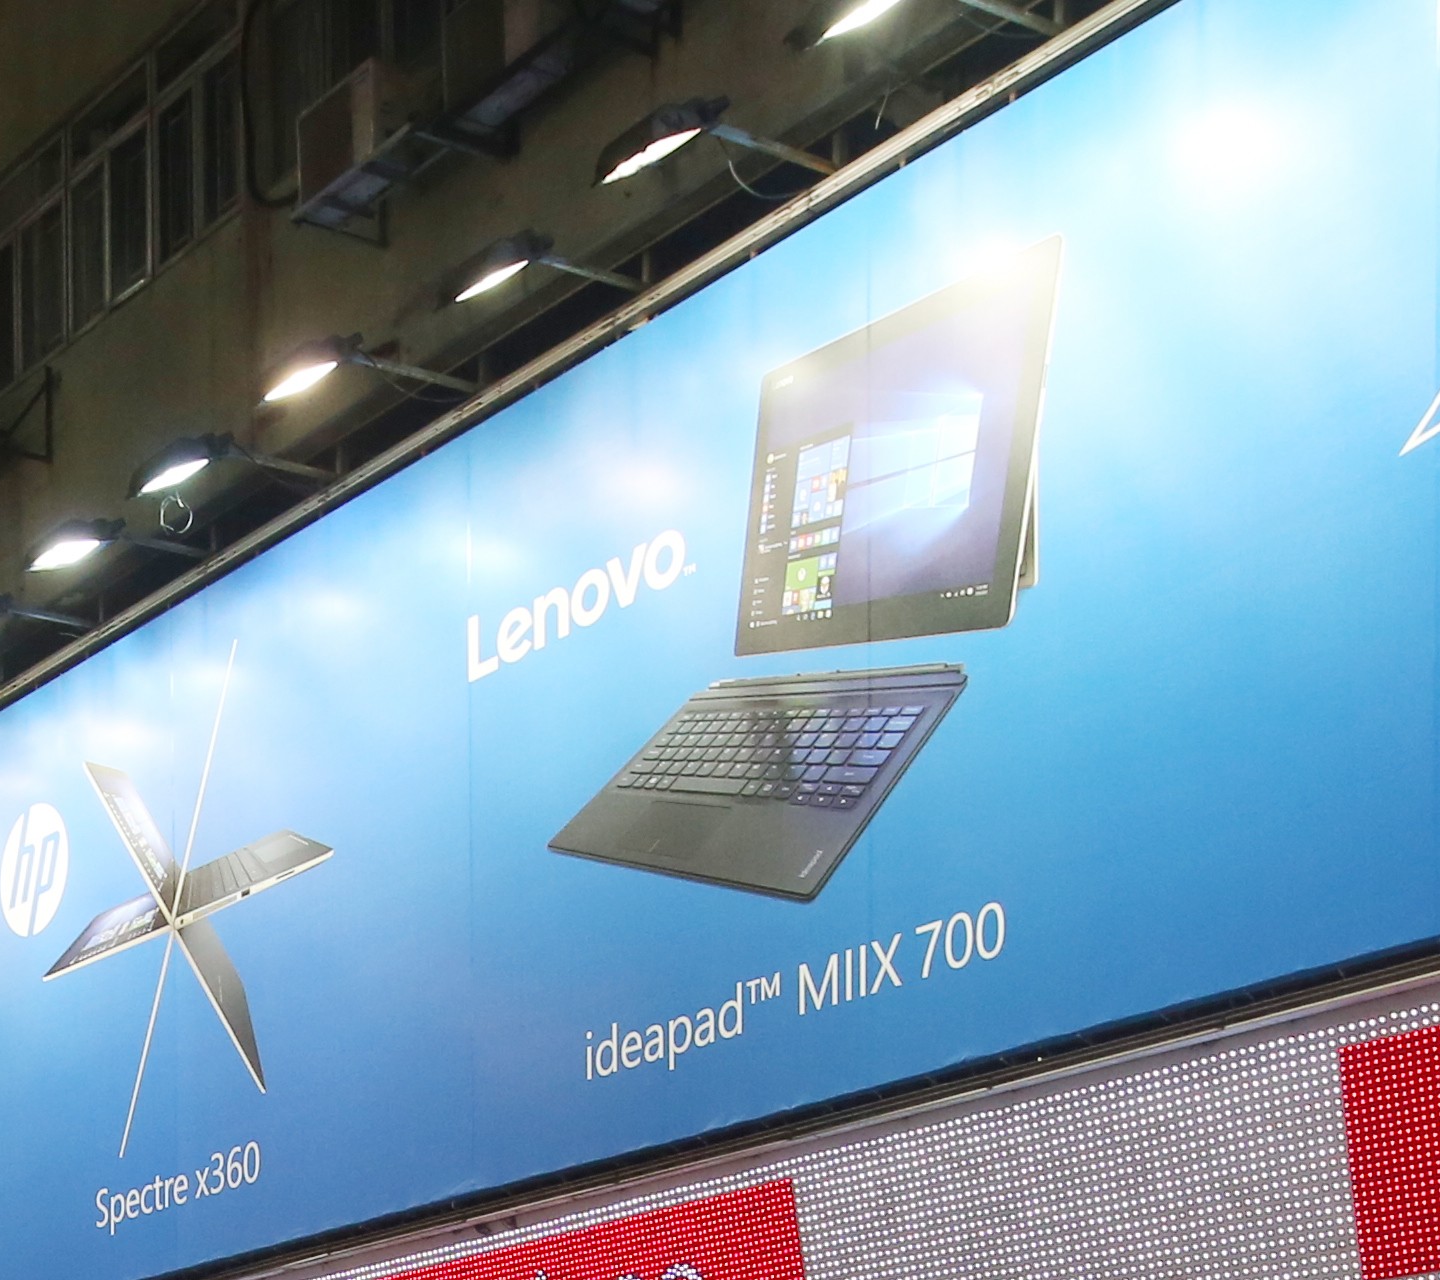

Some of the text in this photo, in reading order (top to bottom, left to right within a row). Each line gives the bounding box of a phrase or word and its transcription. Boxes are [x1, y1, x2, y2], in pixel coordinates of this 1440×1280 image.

[798, 933, 903, 1016] MIIX
[917, 902, 1007, 978] 700
[95, 1140, 261, 1236] Spectre x360
